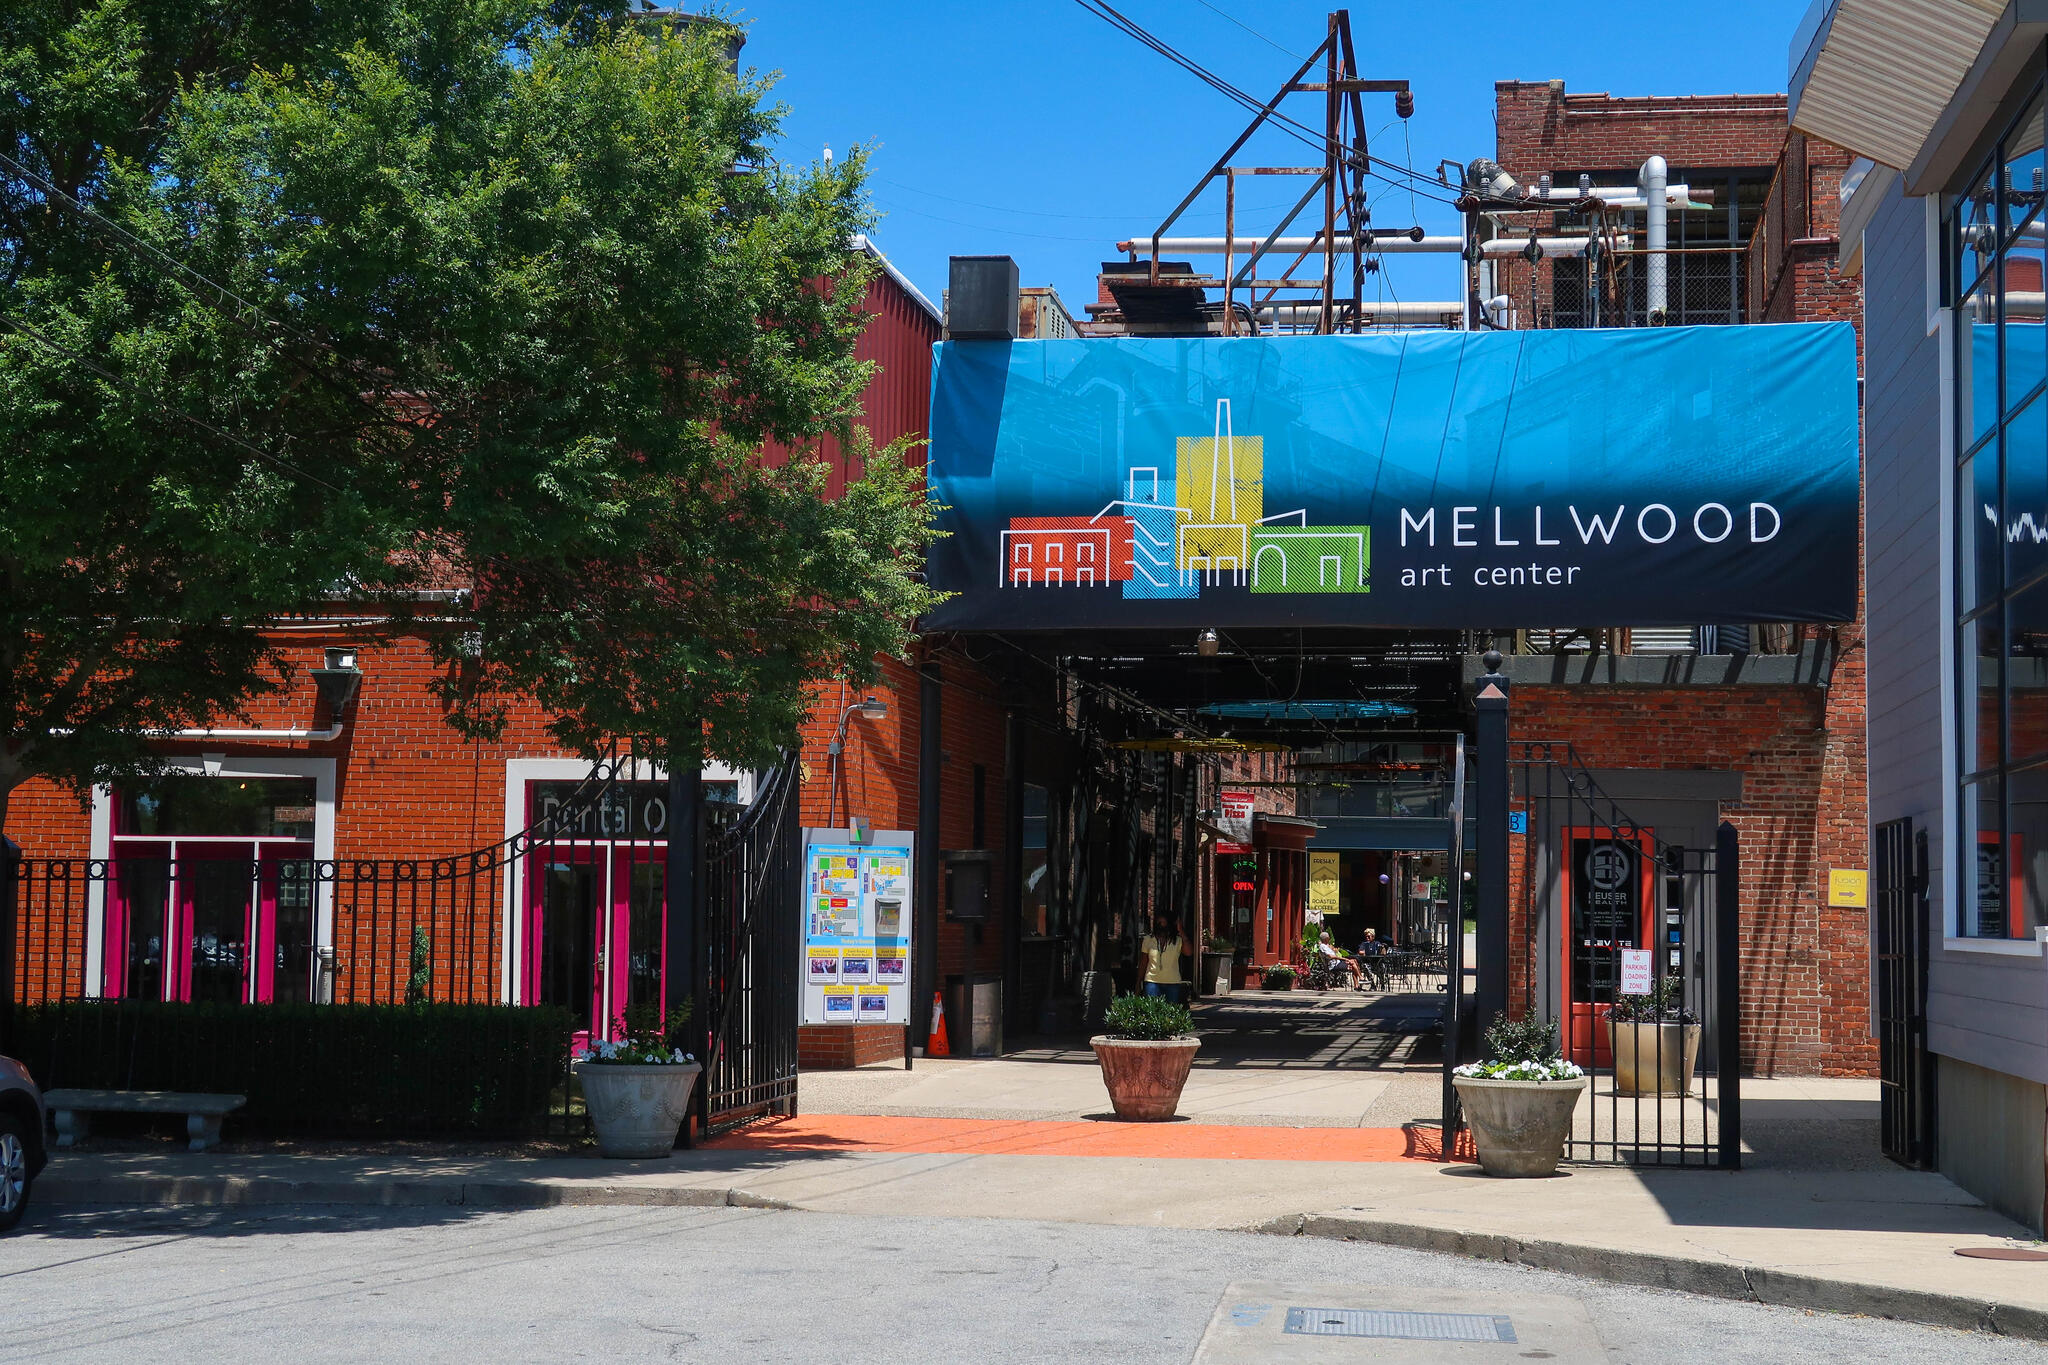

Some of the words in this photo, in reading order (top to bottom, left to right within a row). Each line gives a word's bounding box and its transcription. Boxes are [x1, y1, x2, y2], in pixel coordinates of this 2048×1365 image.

[1400, 502, 1781, 547] MELLWOOD
[1400, 563, 1452, 587] art
[1474, 562, 1581, 586] center
[1510, 815, 1520, 830] B
[1233, 861, 1257, 870] PIZZA
[1233, 882, 1254, 891] OPEN
